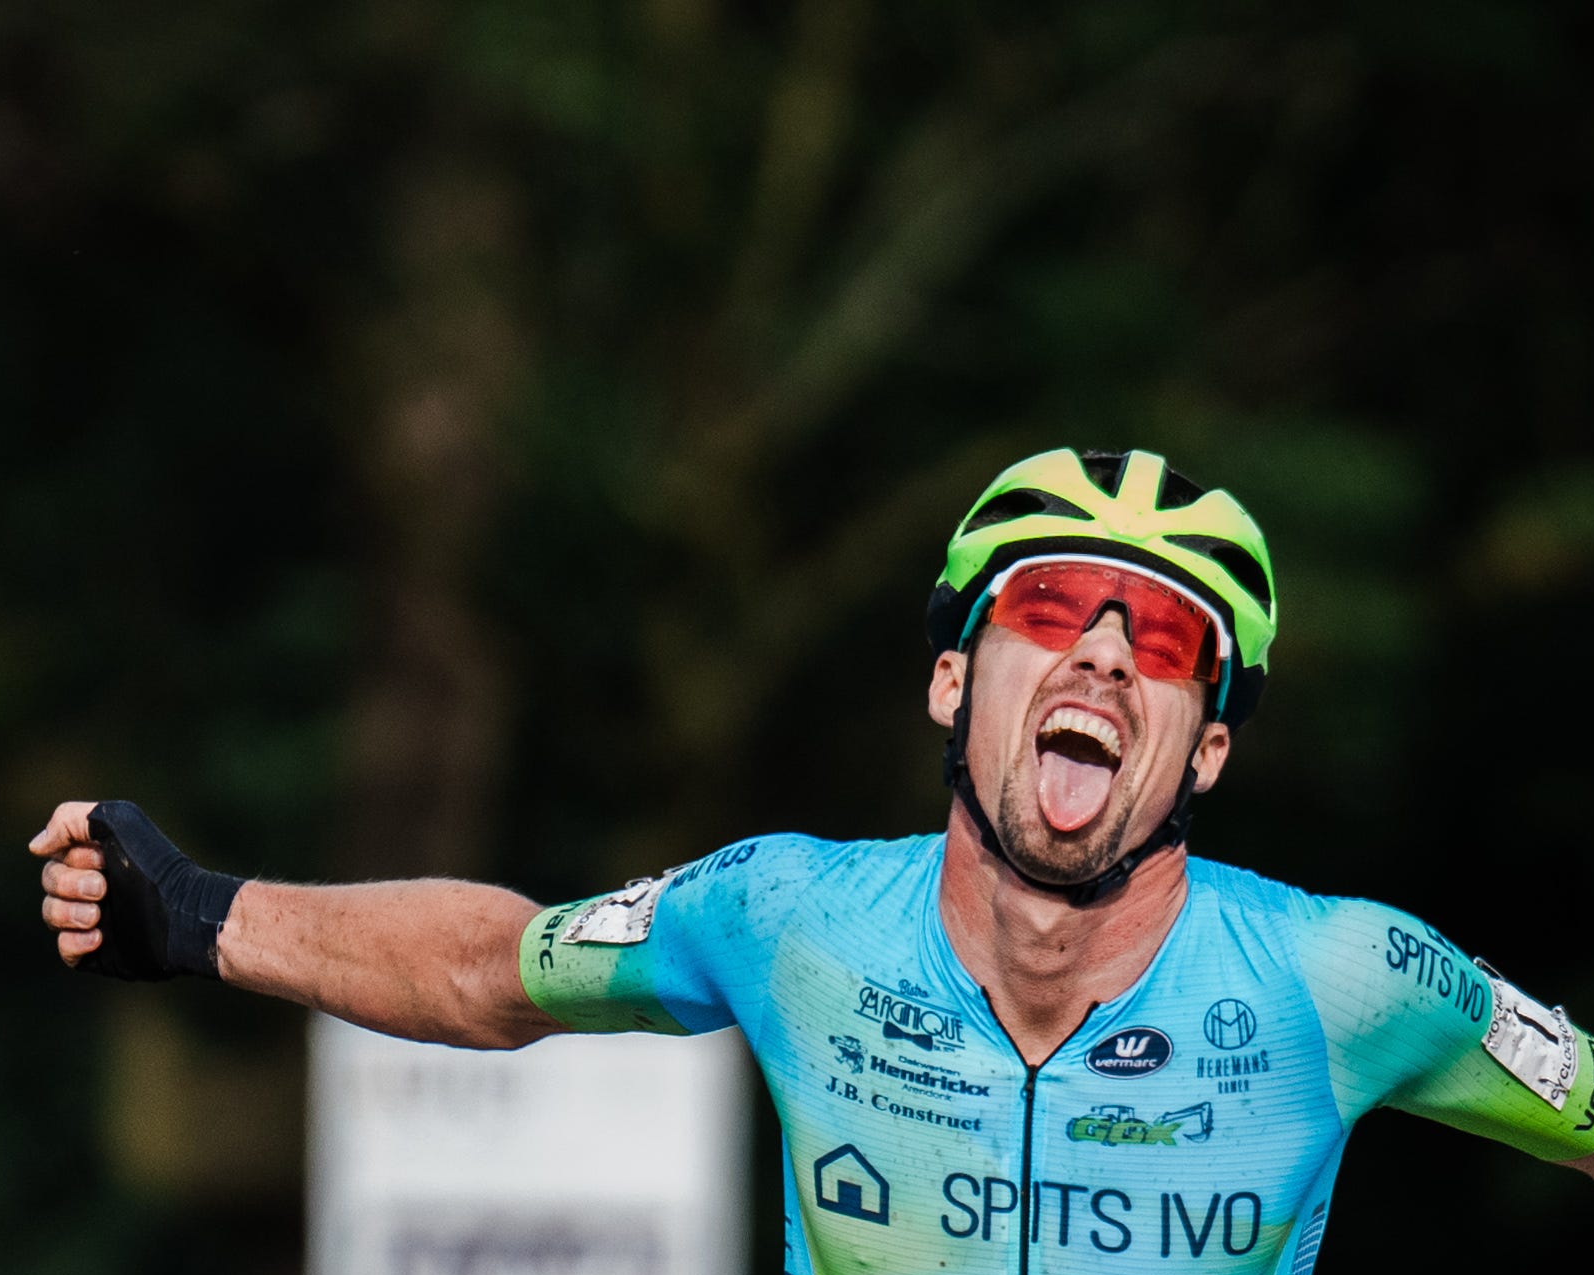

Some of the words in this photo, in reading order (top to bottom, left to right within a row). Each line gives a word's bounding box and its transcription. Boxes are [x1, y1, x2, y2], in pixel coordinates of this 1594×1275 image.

[898, 979, 929, 998] Bistro
[1386, 926, 1453, 998] SPITS
[1455, 969, 1486, 1023] IVO
[871, 1055, 990, 1097] Hendrickx
[1095, 1057, 1157, 1068] vermarc
[1197, 1050, 1270, 1078] HEREMANS
[825, 1075, 864, 1105] J.B.
[871, 1094, 982, 1132] Construct
[940, 1172, 1132, 1254] SPITS
[1159, 1191, 1263, 1259] IVO
